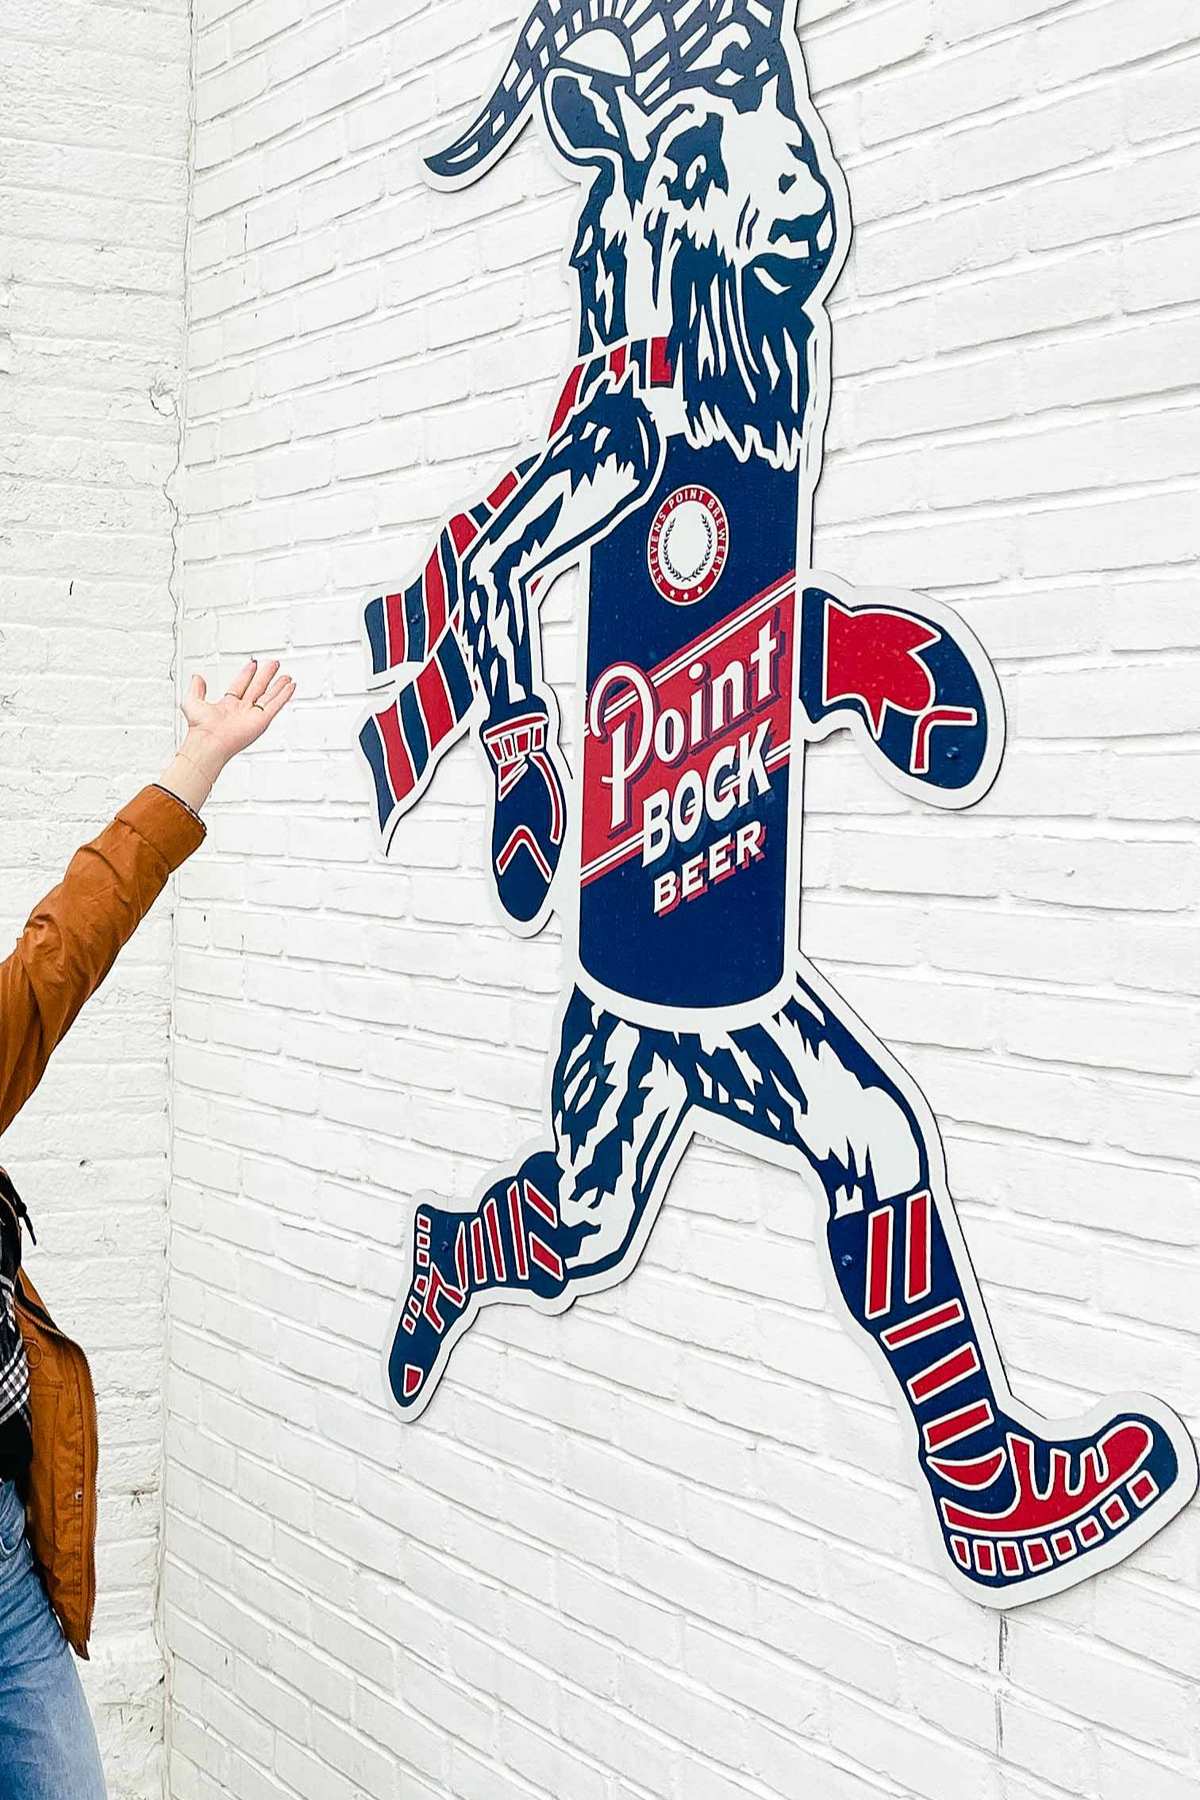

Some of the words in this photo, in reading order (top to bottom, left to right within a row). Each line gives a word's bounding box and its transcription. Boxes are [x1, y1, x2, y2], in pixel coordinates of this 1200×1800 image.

[650, 511, 667, 584] STEVENS
[668, 489, 705, 509] POINT
[707, 498, 727, 577] BREWERY
[590, 619, 778, 830] Point
[642, 718, 773, 868] BOCK
[653, 820, 764, 915] BEER
